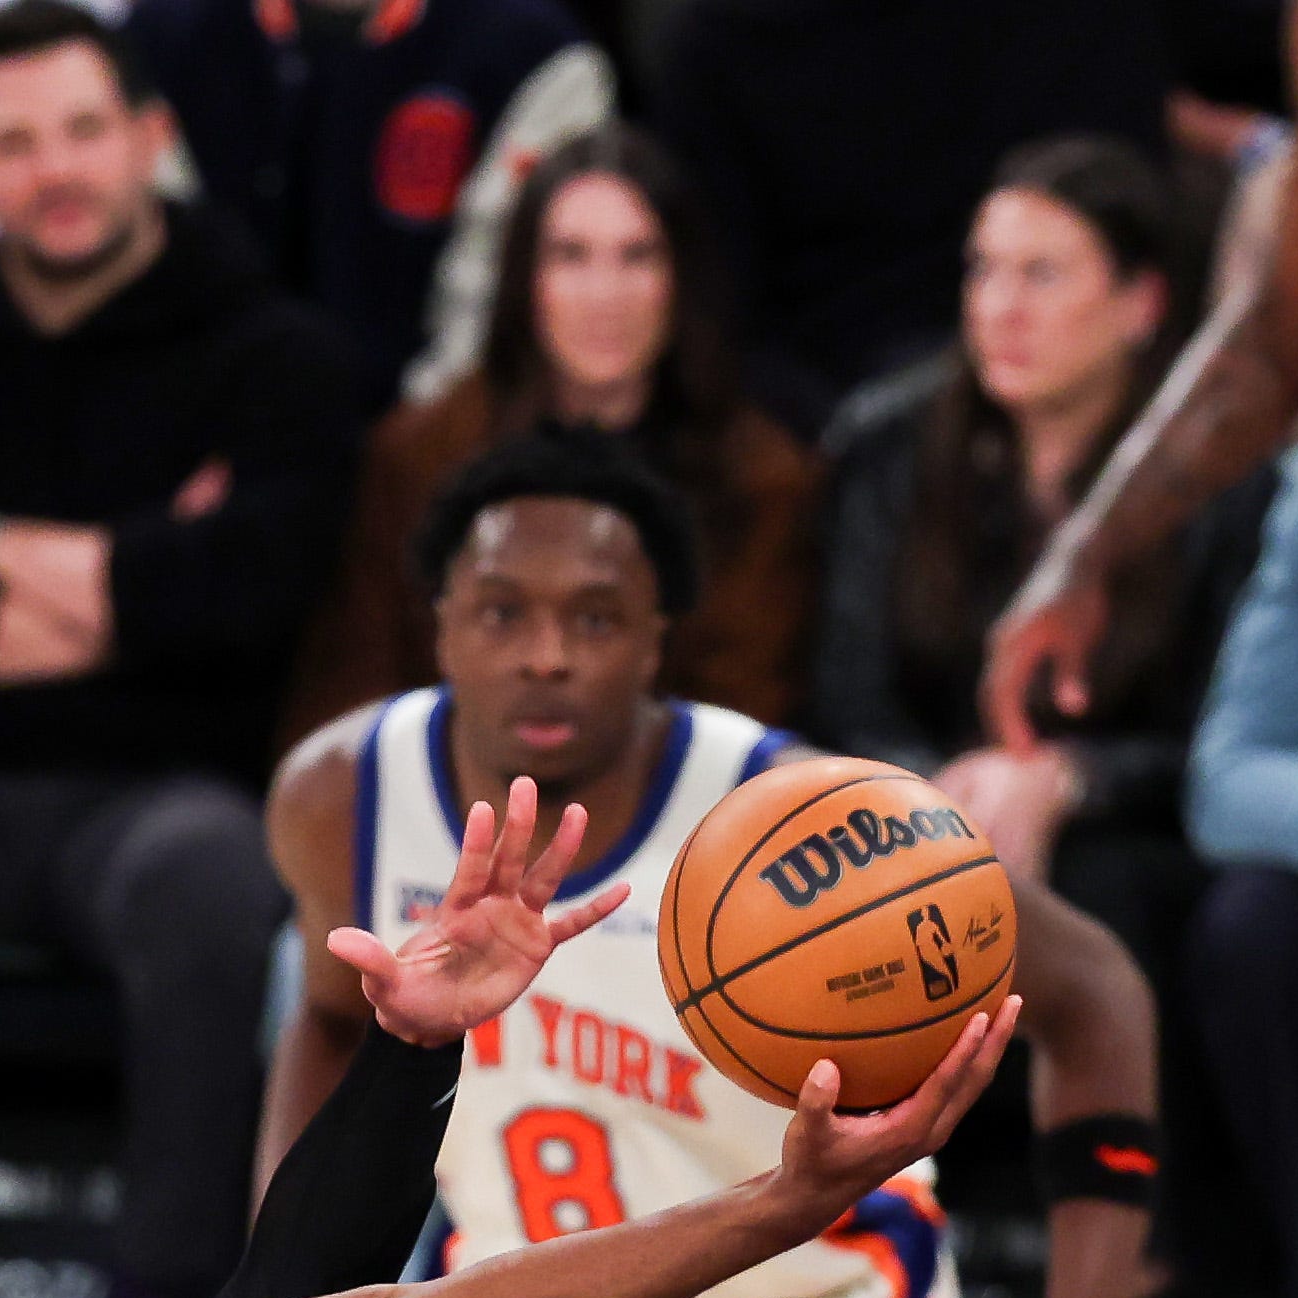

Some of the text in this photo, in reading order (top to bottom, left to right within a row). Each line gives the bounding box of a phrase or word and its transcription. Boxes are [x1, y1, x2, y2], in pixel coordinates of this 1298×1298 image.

[758, 808, 975, 908] Wilson
[531, 994, 708, 1122] YORK
[501, 1106, 626, 1243] 8
